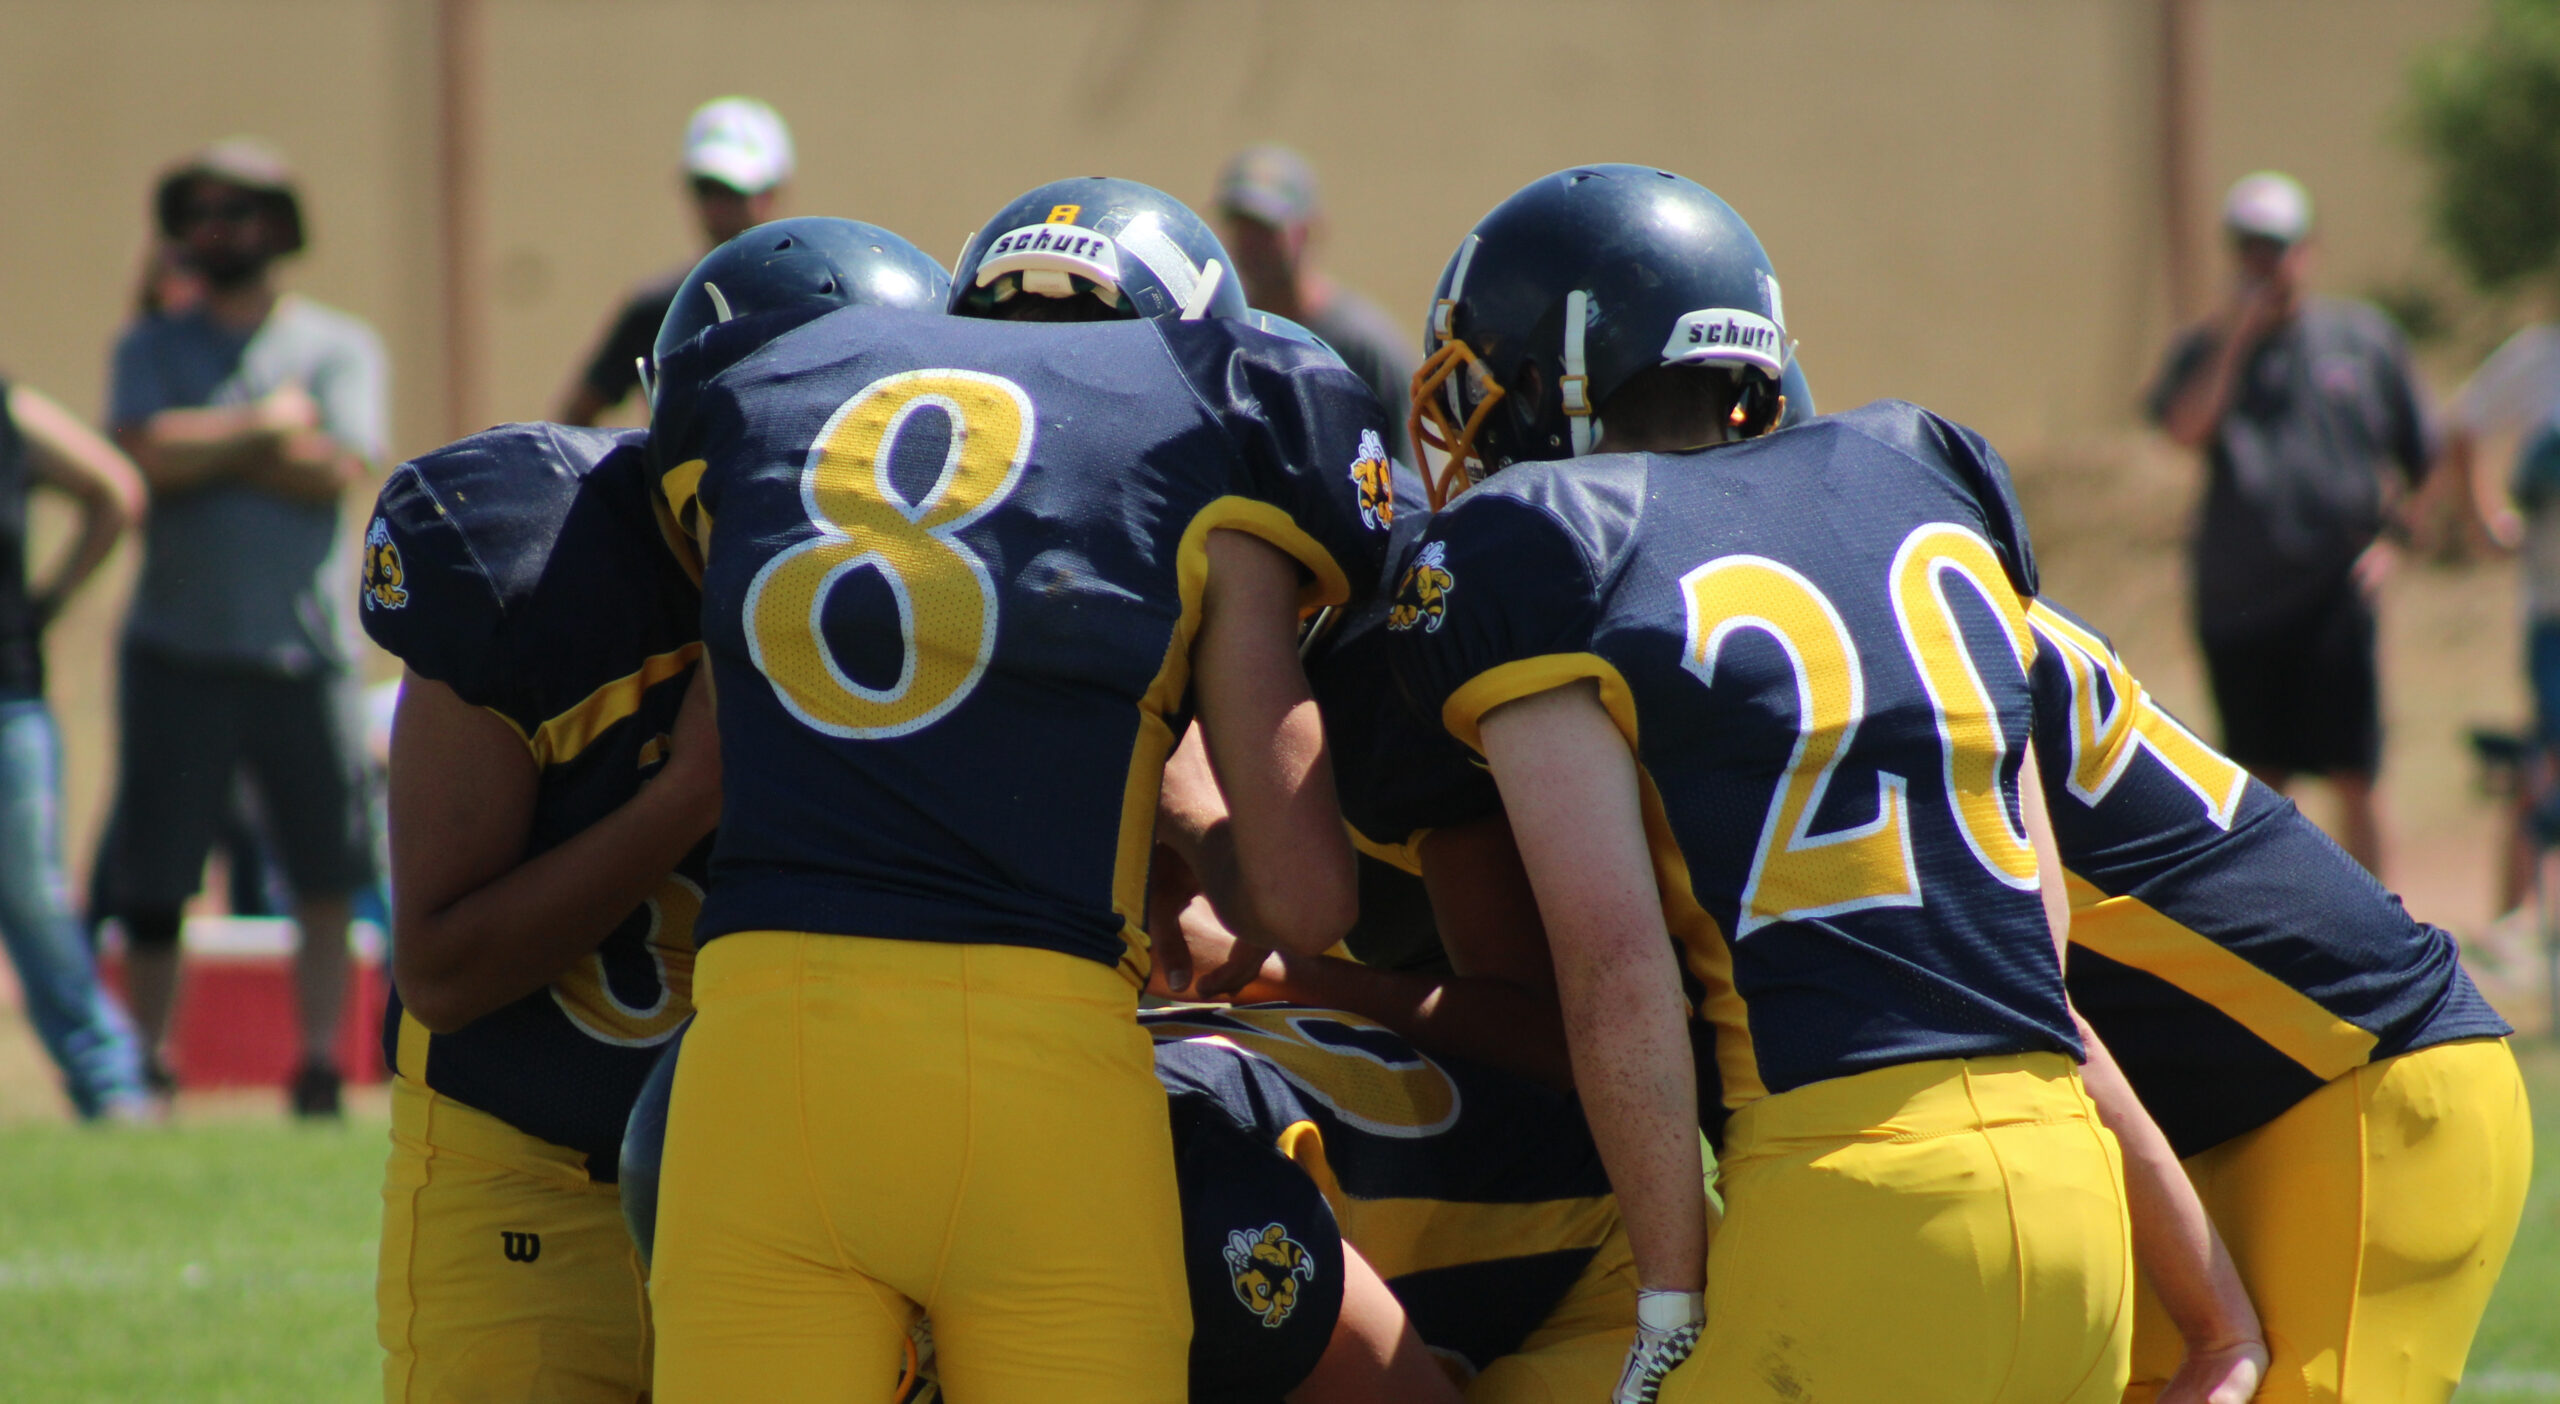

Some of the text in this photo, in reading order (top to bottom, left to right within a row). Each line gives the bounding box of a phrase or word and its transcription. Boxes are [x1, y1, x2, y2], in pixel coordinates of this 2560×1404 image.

[1045, 204, 1081, 226] 8
[742, 368, 1036, 740] 8
[1680, 522, 2040, 943] 20
